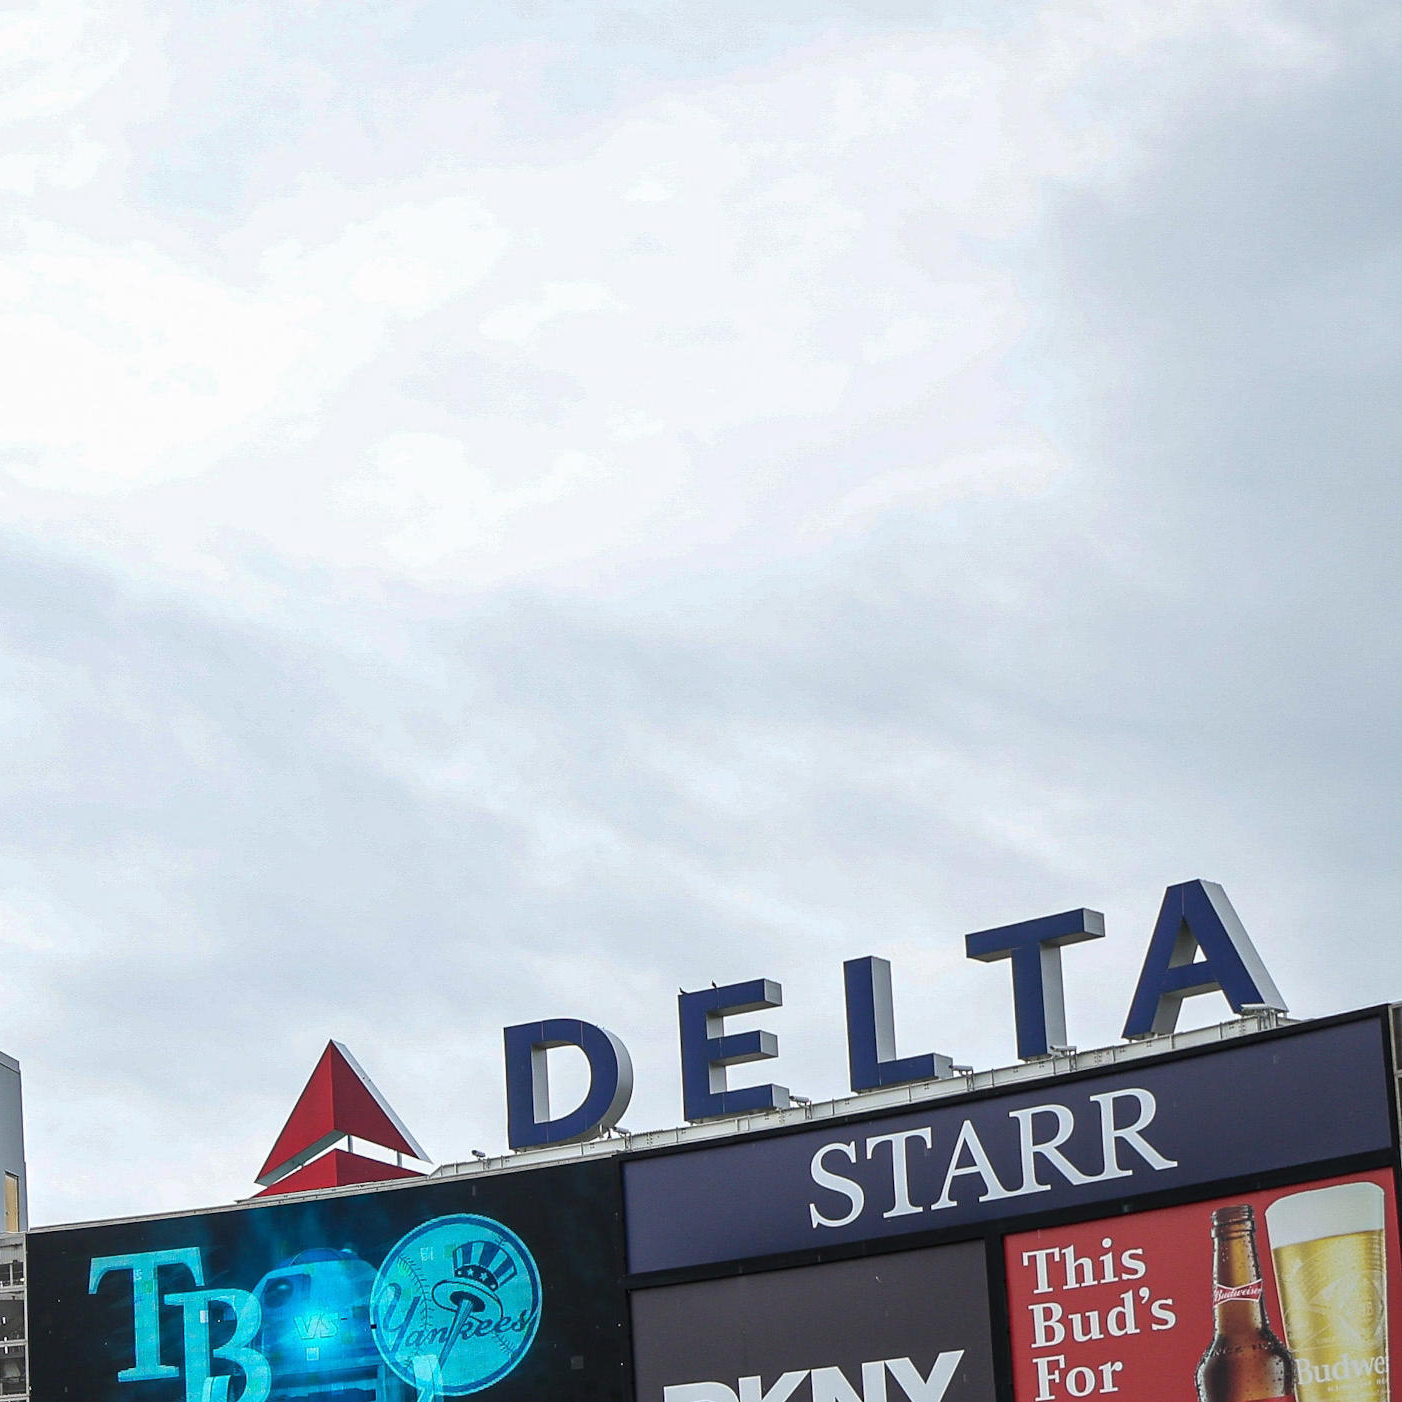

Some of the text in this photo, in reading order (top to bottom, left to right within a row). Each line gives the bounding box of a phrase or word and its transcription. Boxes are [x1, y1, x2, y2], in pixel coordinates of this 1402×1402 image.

[503, 878, 1288, 1151] DELTA
[809, 1087, 1178, 1229] STARR
[1022, 1237, 1147, 1296] This
[383, 1283, 529, 1353] Yankees
[1028, 1287, 1177, 1349] Bud's
[1034, 1356, 1123, 1402] For
